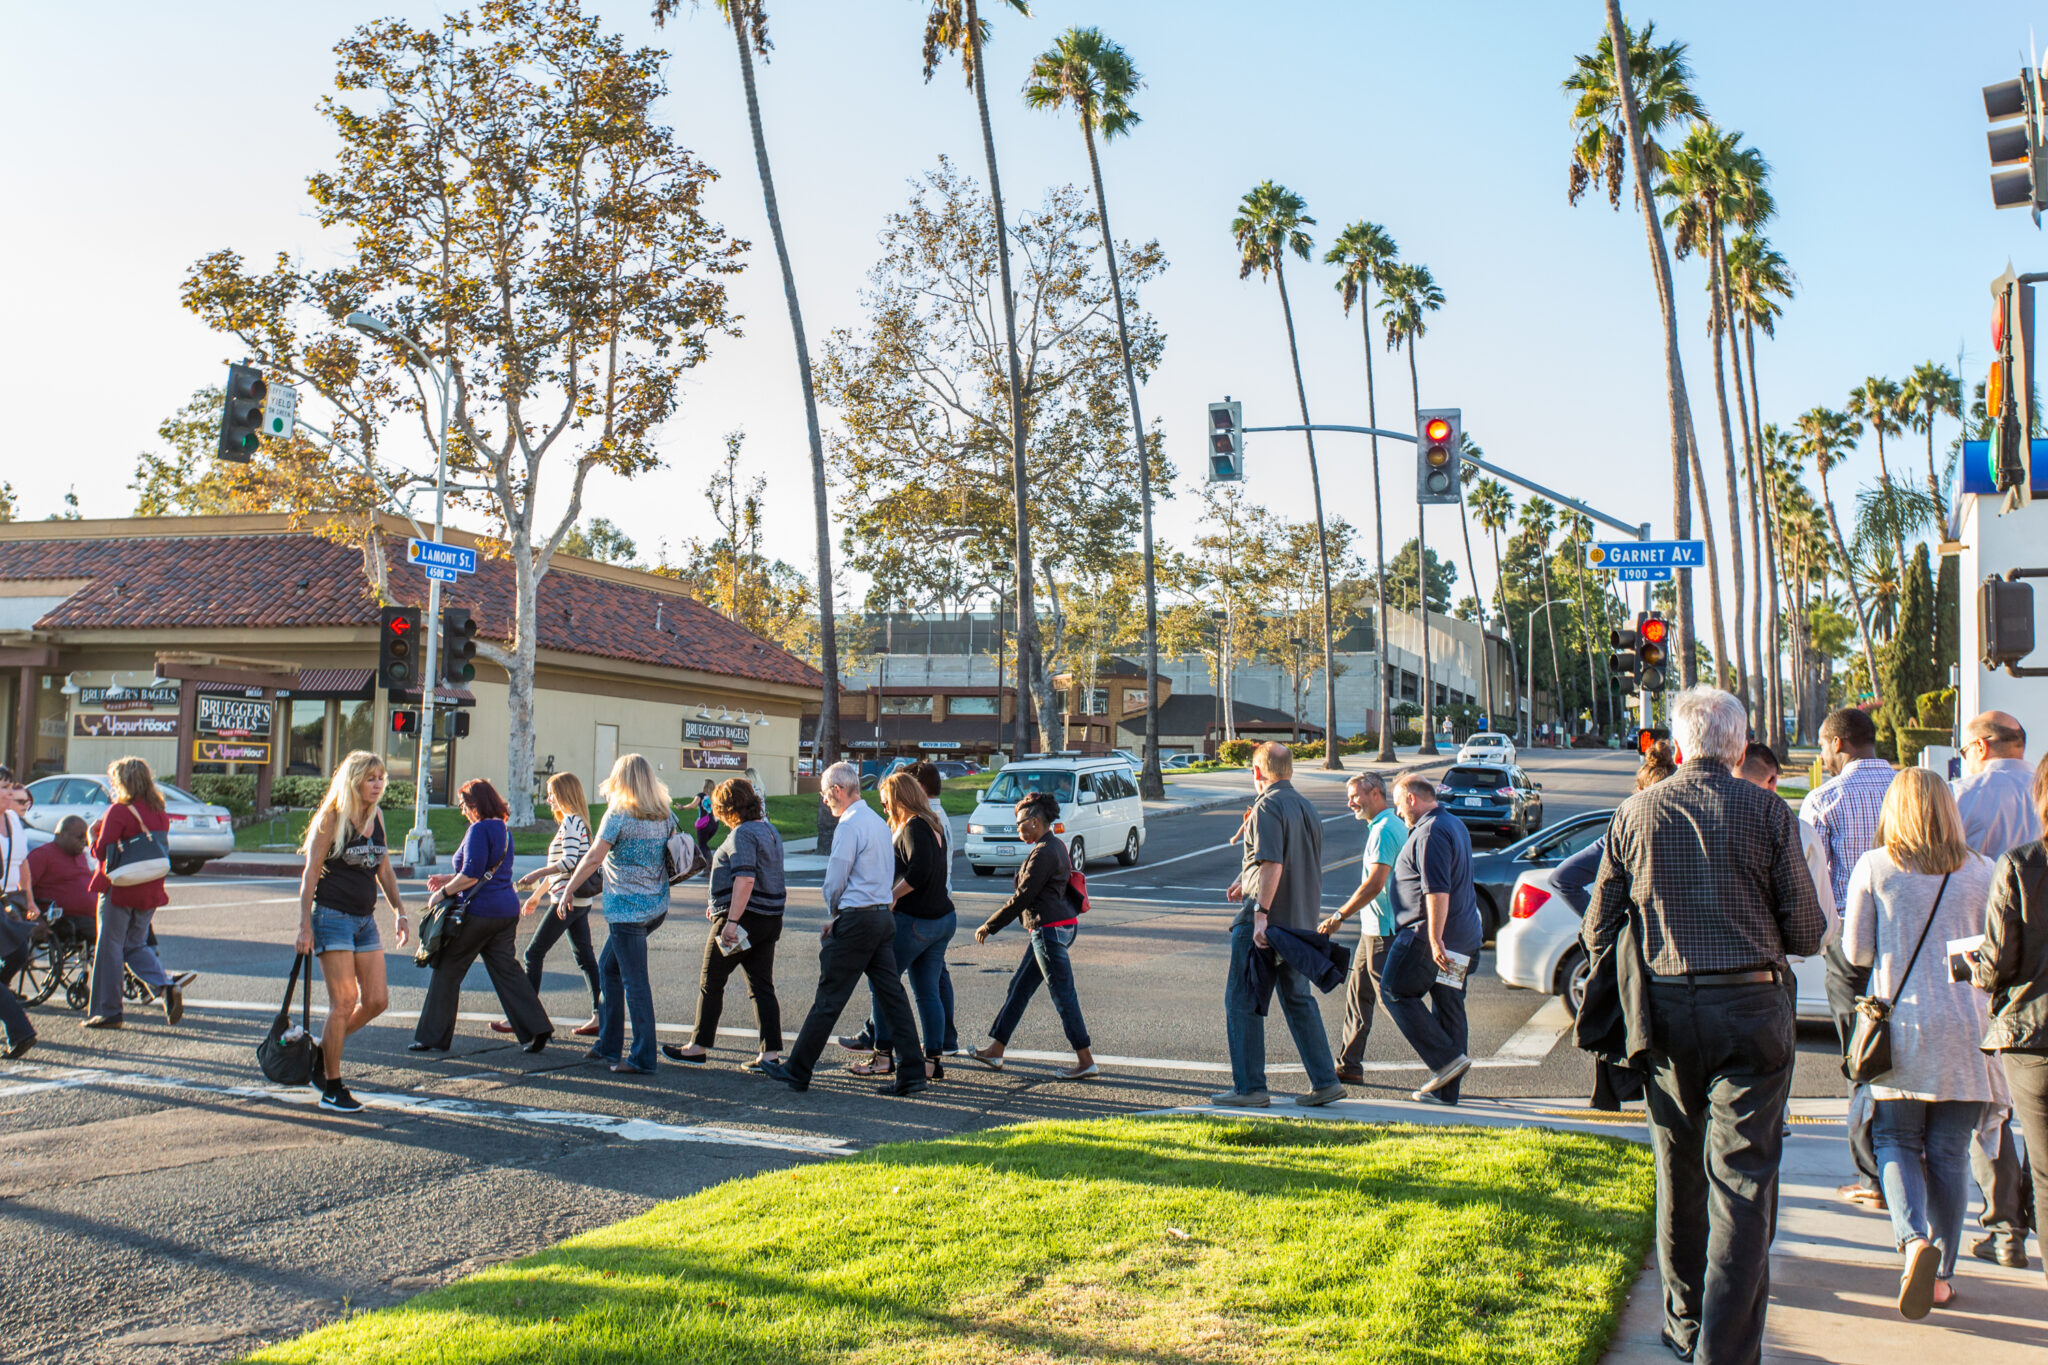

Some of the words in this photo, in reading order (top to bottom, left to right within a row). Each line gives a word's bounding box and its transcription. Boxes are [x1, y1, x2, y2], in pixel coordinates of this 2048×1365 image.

[272, 396, 291, 408] YIELD
[422, 545, 456, 565] LAMONT
[459, 552, 471, 568] ST.
[1610, 547, 1665, 562] GARNET
[1672, 546, 1696, 562] AV.
[430, 568, 444, 578] 4500
[1624, 569, 1648, 579] 1900
[141, 689, 177, 703] BAGELS
[201, 699, 270, 722] BRUEGGER'S
[212, 714, 257, 731] BAGELS
[686, 723, 724, 737] BRUEGGER'S
[726, 727, 748, 743] BAGELS
